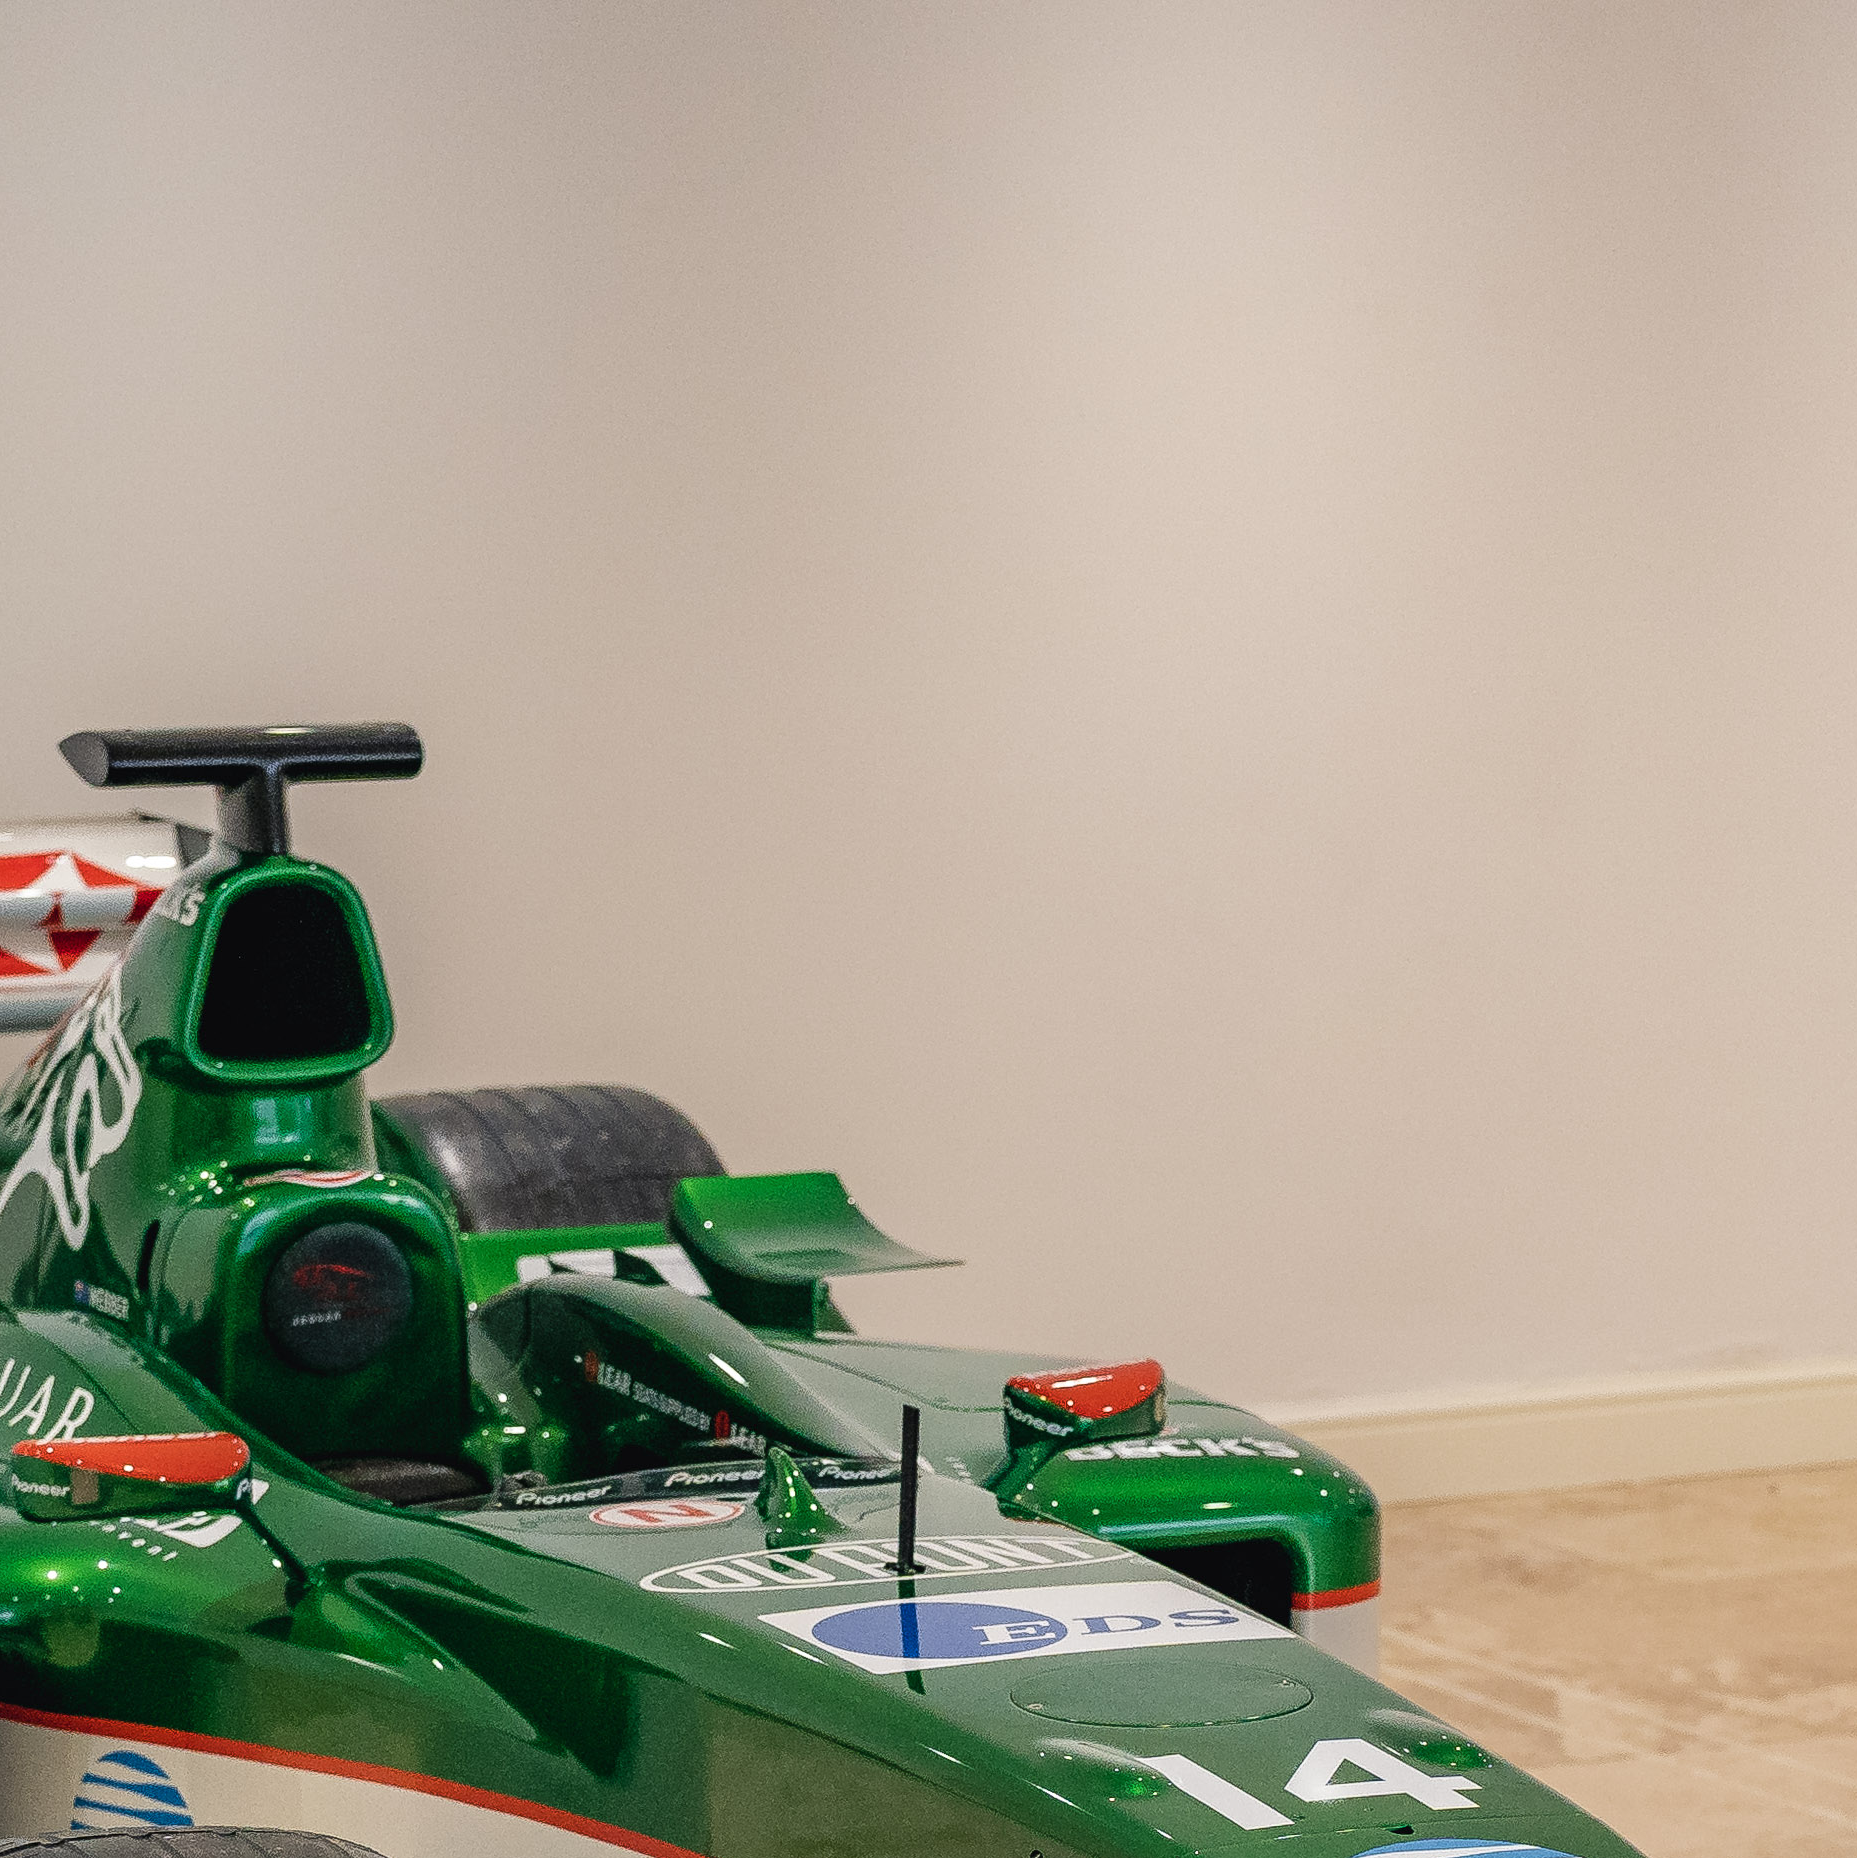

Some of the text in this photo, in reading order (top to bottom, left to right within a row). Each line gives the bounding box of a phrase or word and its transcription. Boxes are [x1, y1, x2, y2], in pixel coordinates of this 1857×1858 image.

[515, 1484, 613, 1507] Pioneer
[971, 1608, 1241, 1647] EDS
[1134, 1738, 1483, 1831] 14
